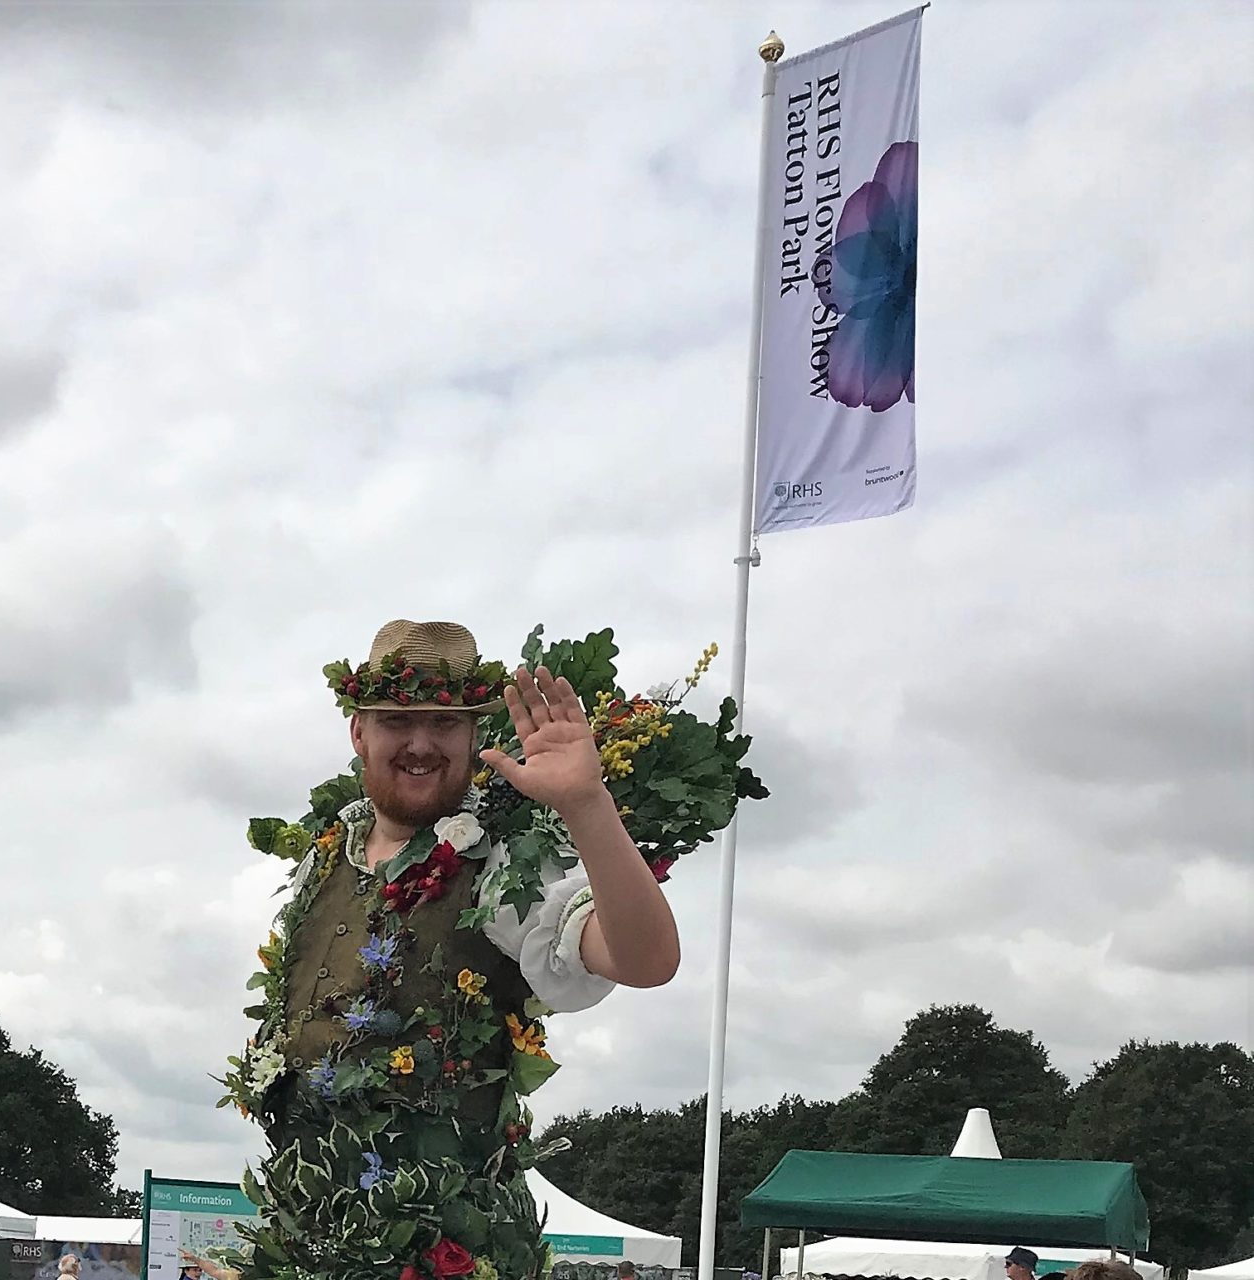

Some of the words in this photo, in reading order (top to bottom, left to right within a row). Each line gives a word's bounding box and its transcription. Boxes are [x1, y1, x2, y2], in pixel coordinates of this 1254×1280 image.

[784, 82, 813, 209] Tatton
[817, 69, 842, 160] RHS
[780, 211, 809, 298] Park
[814, 164, 842, 293] Flower
[810, 303, 839, 401] Show
[792, 481, 823, 499] RHS
[179, 1193, 232, 1206] Information
[22, 1245, 43, 1257] RHS
